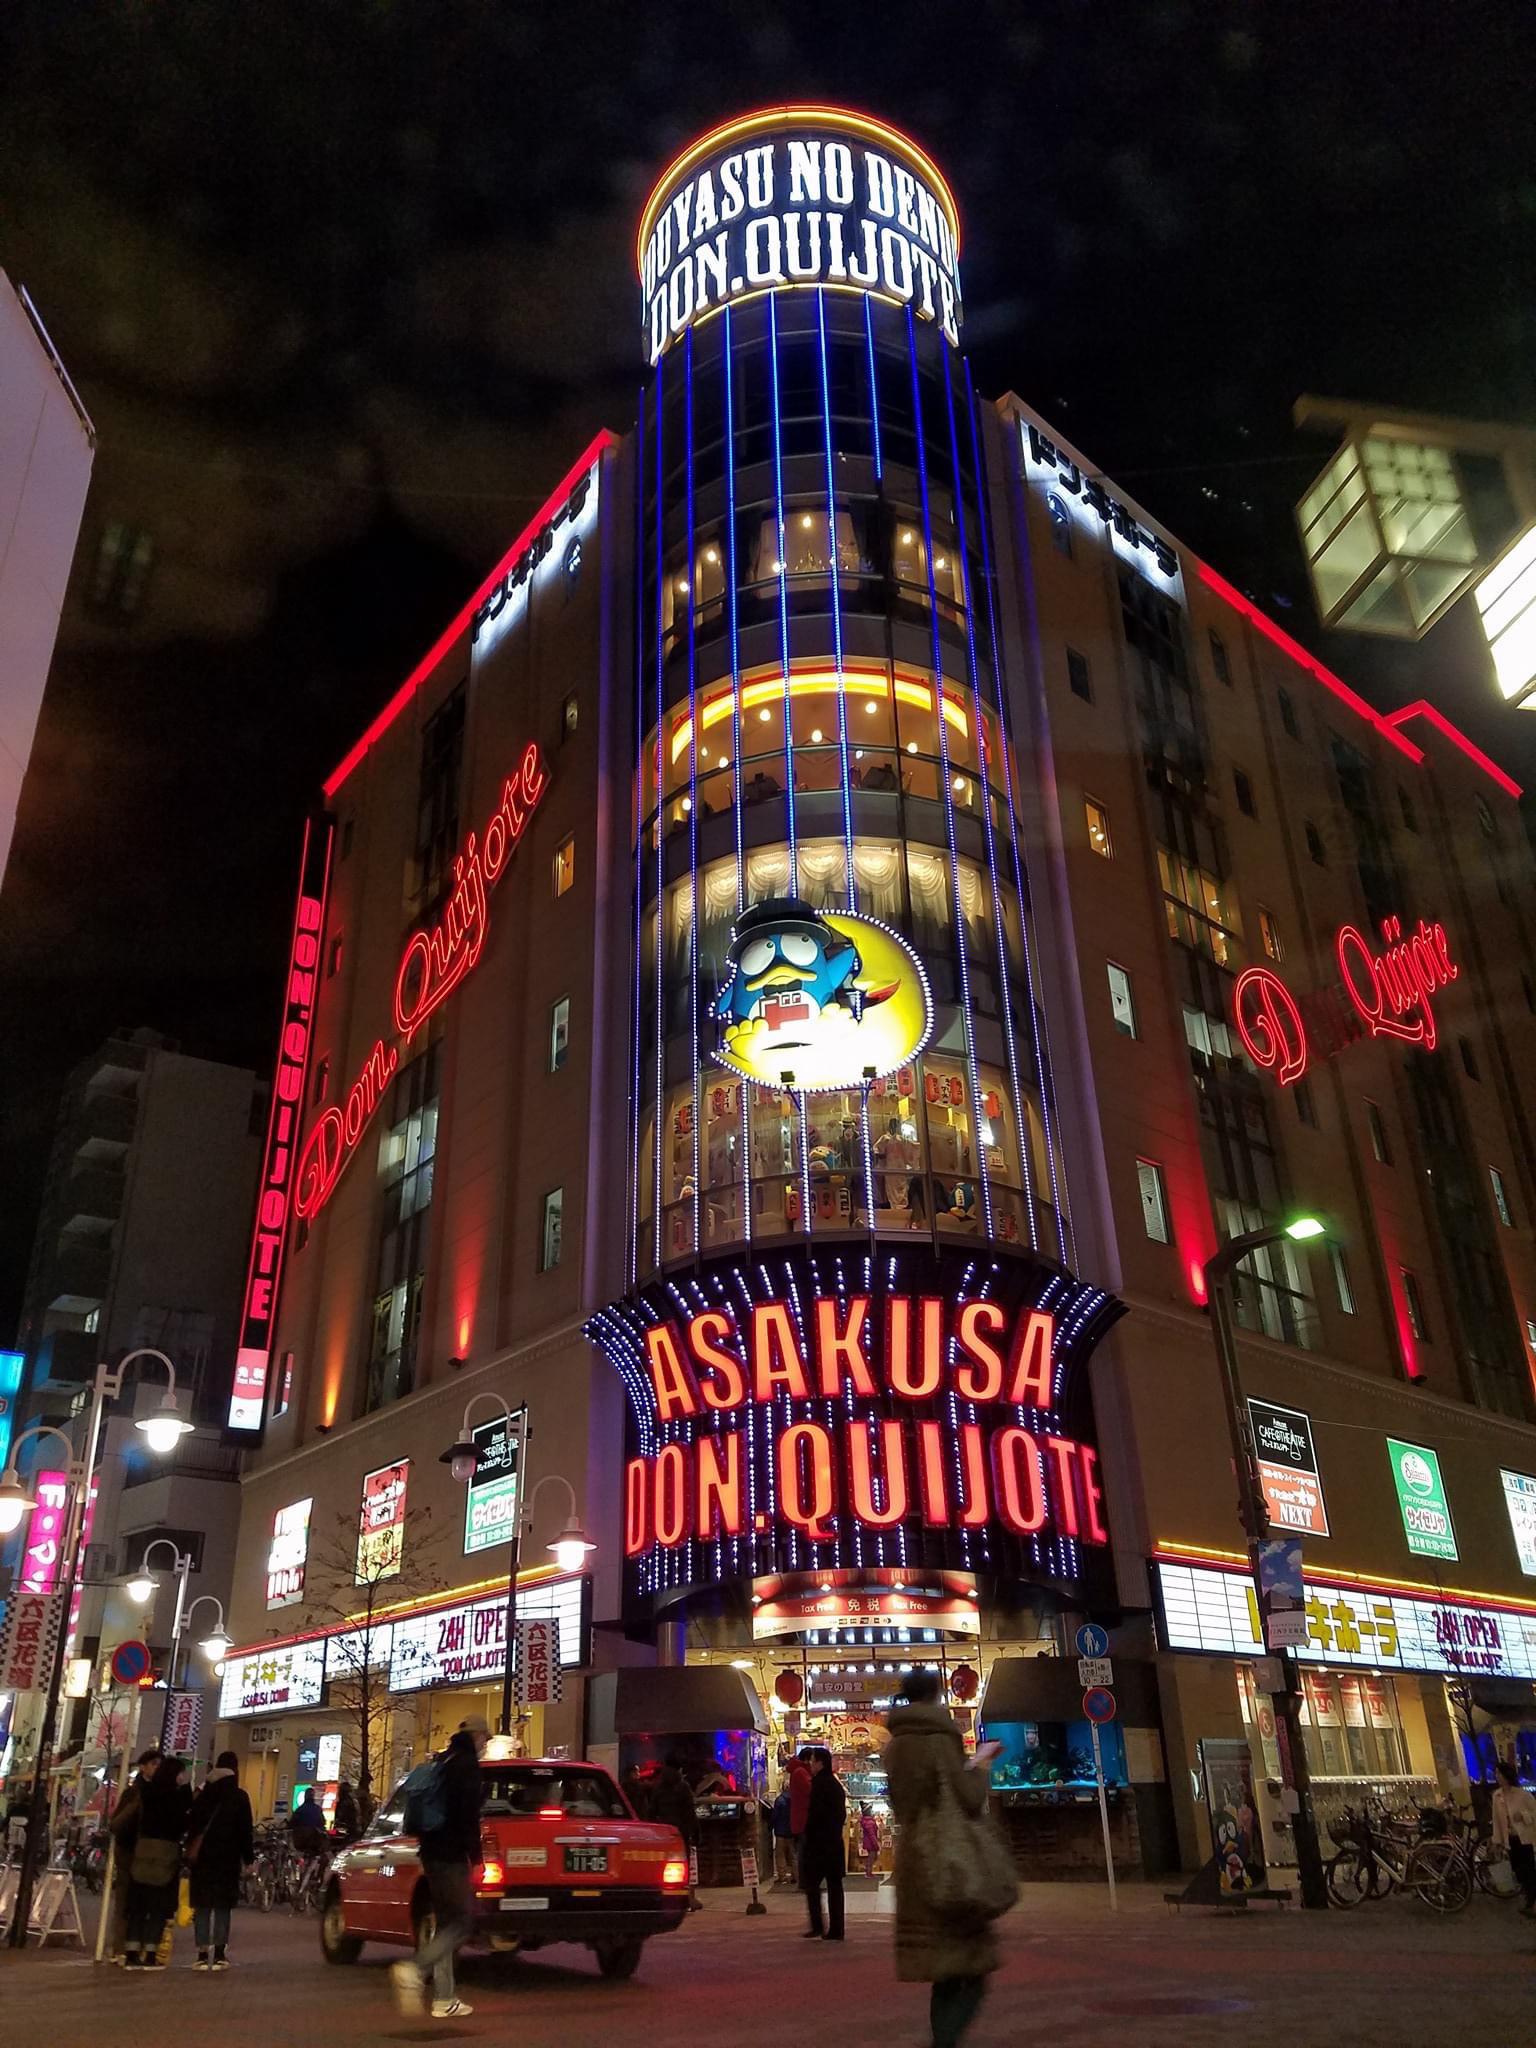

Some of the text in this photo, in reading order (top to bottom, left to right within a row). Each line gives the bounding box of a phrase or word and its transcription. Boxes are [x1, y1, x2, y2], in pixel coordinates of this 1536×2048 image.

[643, 145, 774, 310] OUYASU
[787, 141, 853, 205] NO
[650, 212, 959, 367] DON.QUIJOTE
[394, 743, 543, 1044] Quijote
[1338, 915, 1458, 1050] Quijote
[249, 895, 321, 1320] DON.QUIJOTE
[645, 1297, 1056, 1421] ASAKUSA
[624, 1420, 1108, 1558] DON.QUIJOTE
[1279, 1502, 1312, 1528] NEXT
[437, 1605, 507, 1654] 24H OPE
[527, 1622, 549, 1702] 六区花道
[1464, 1614, 1503, 1650] OPEN
